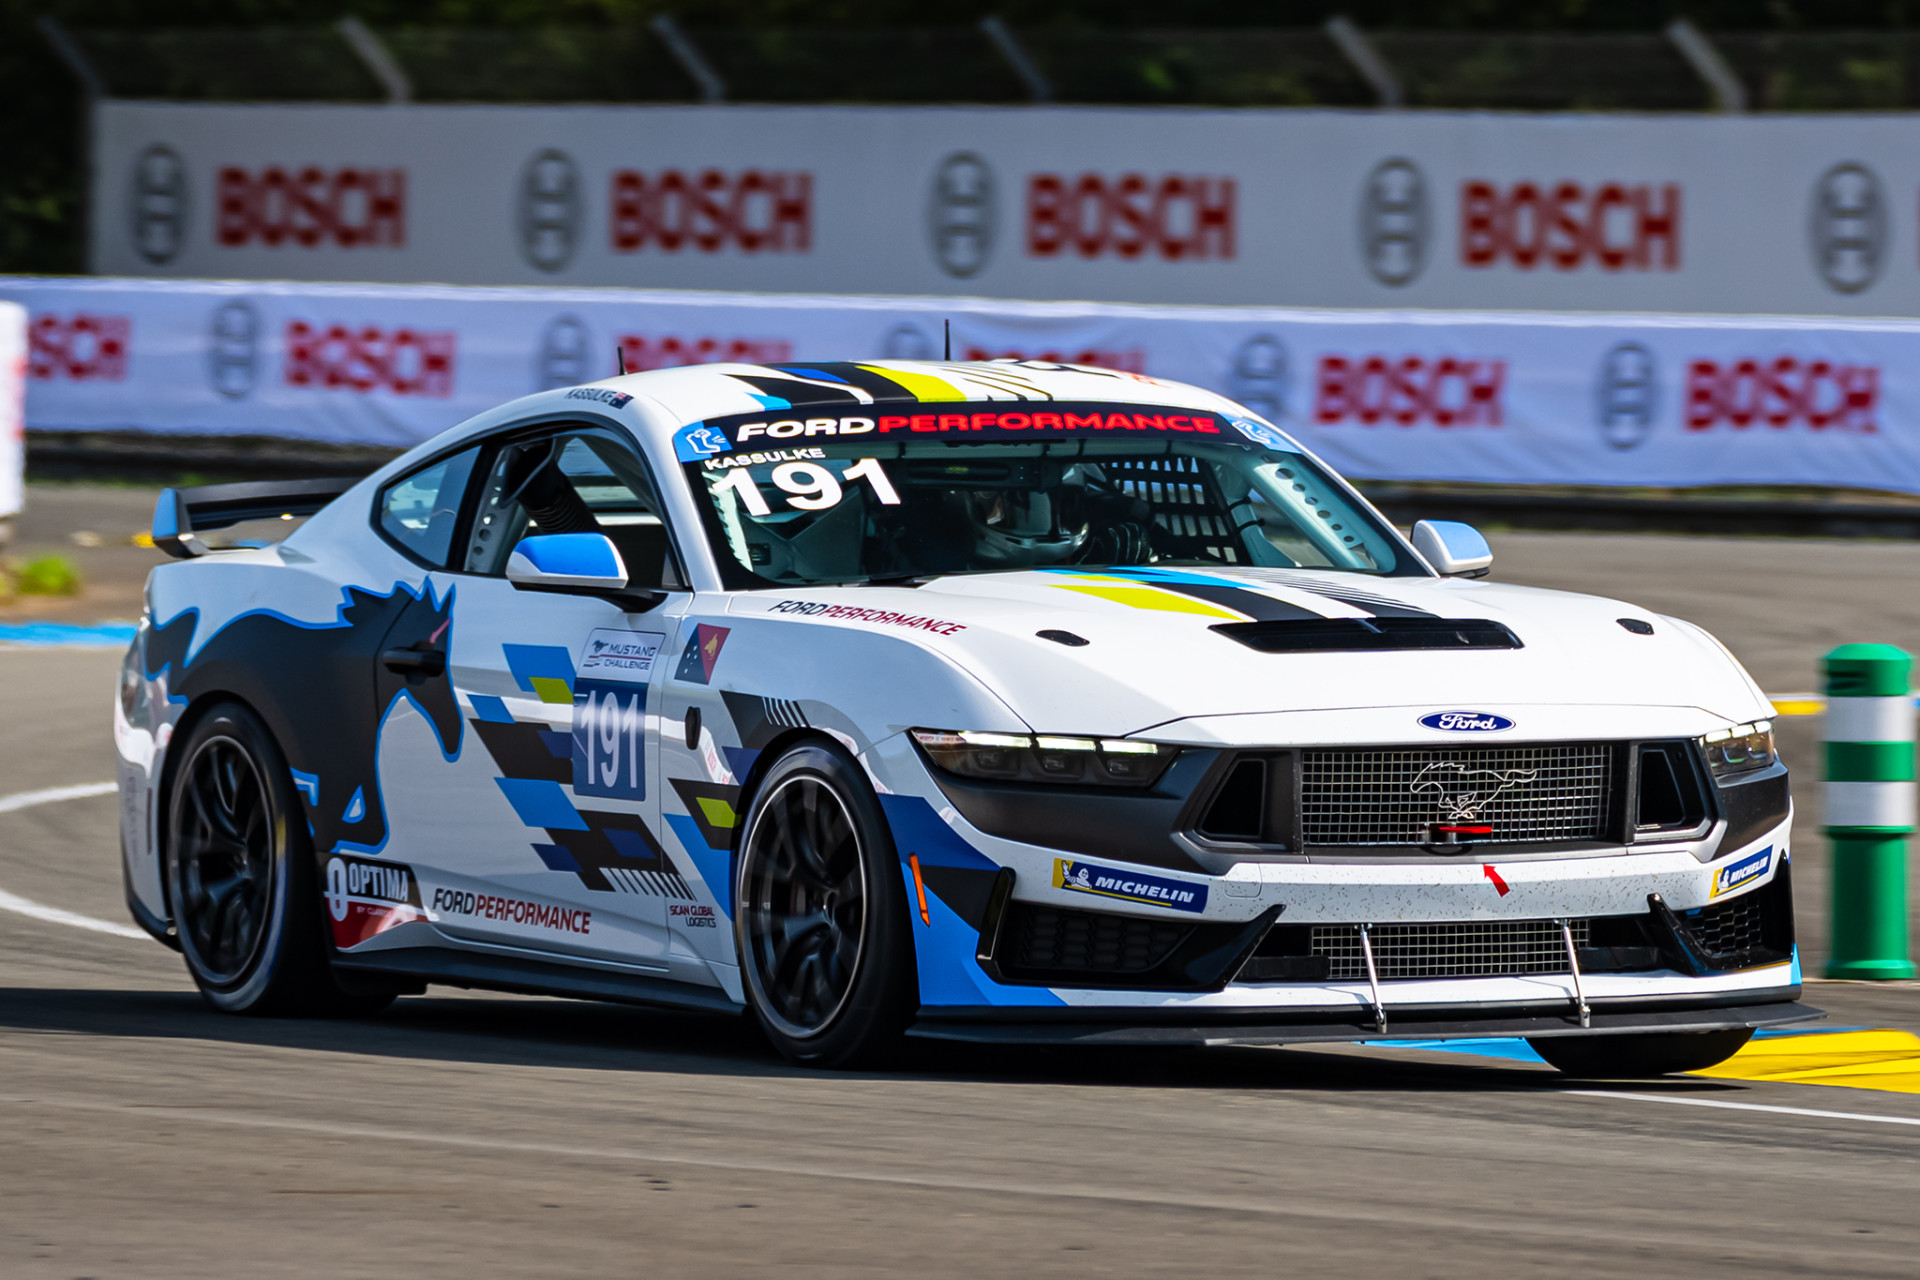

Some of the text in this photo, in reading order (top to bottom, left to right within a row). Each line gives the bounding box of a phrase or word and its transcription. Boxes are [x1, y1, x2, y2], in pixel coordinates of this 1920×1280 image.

[215, 166, 406, 248] BOSCH
[610, 171, 812, 252] BOSCH
[1026, 174, 1237, 260] BOSCH
[1459, 179, 1682, 271] BOSCH
[28, 313, 129, 381] SCH
[285, 319, 456, 397] BOSCH
[1316, 355, 1506, 426] BOSCH
[1684, 357, 1880, 432] BOSCH
[704, 448, 826, 471] KASSULKE
[712, 457, 901, 517] 191
[604, 659, 650, 671] CHALLENGE
[608, 643, 656, 657] MUSTANG
[580, 690, 639, 788] 191
[1438, 713, 1497, 730] Ford
[348, 862, 409, 903] OPTIMA
[1095, 876, 1195, 903] MICHELIN
[1730, 855, 1769, 884] MICHELIN
[669, 905, 715, 916] SCAN GLOBAL
[685, 916, 717, 928] LOGISTICS
